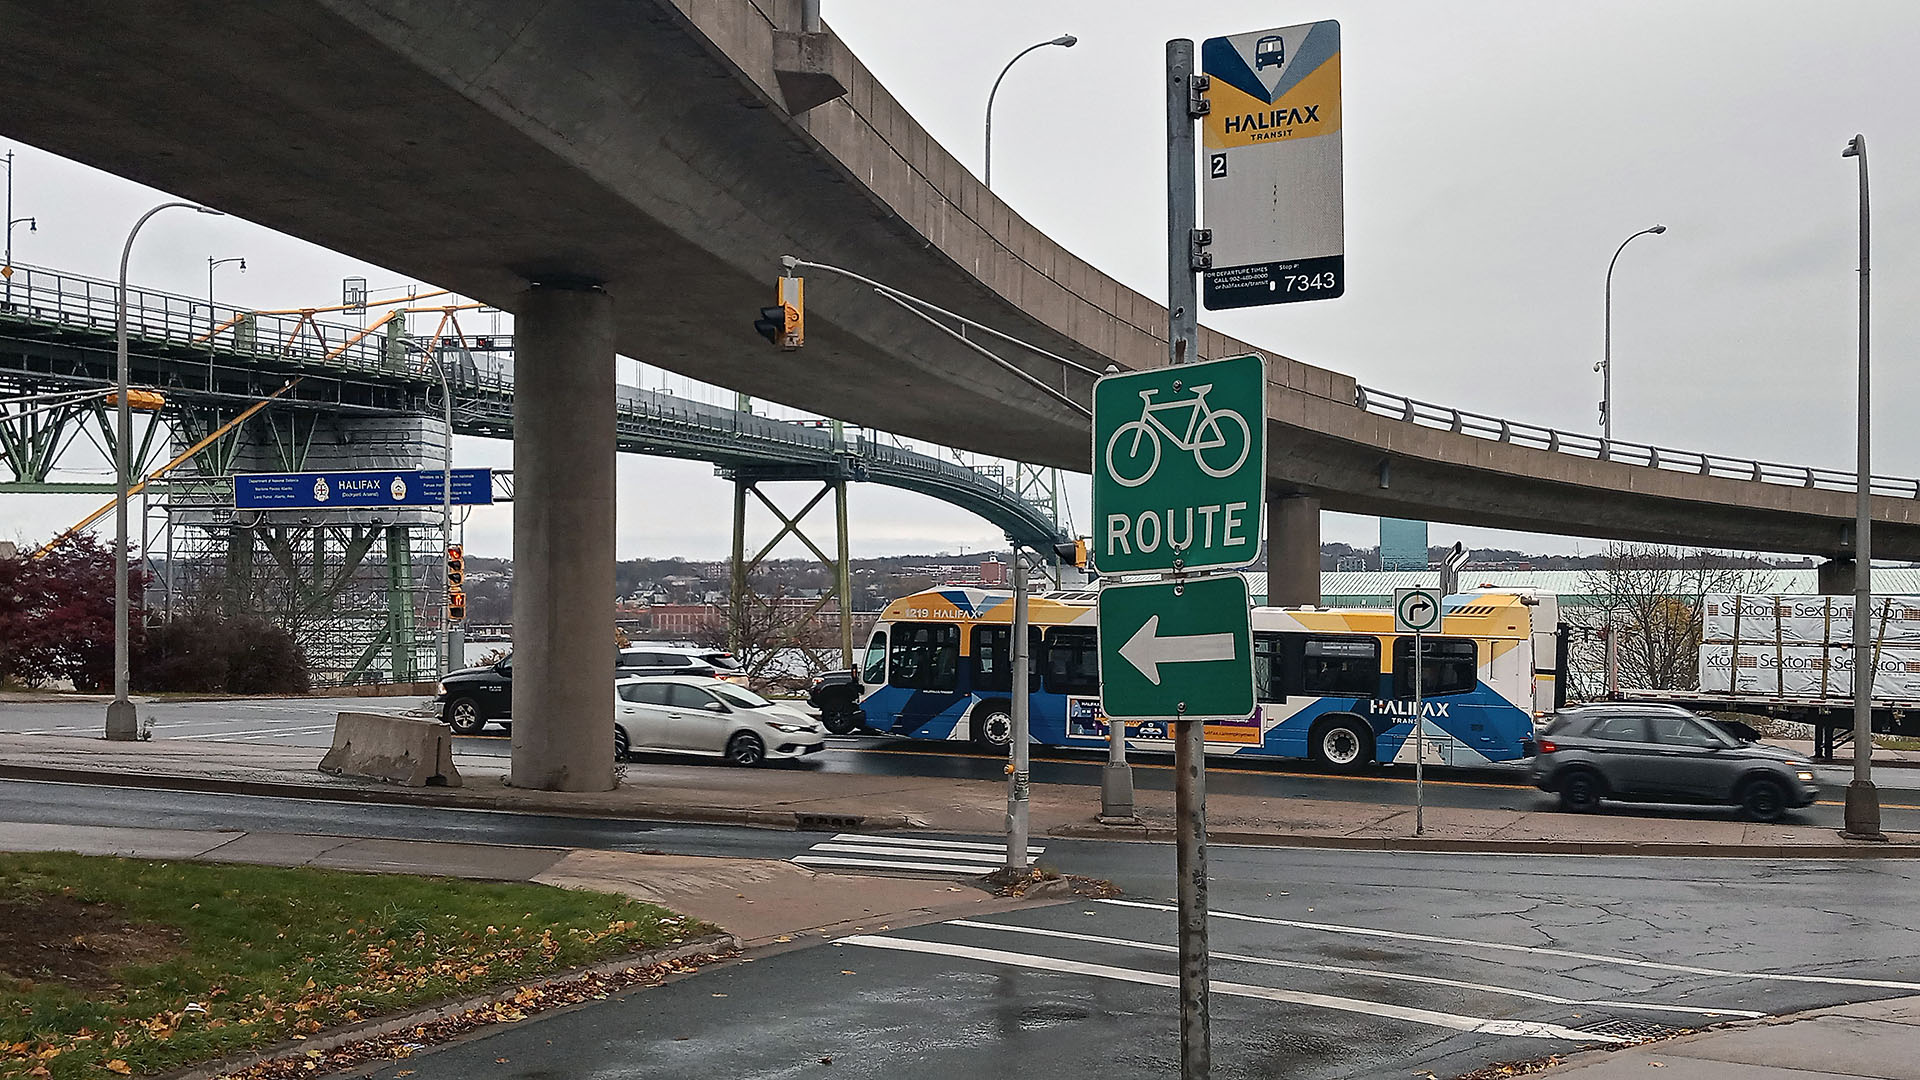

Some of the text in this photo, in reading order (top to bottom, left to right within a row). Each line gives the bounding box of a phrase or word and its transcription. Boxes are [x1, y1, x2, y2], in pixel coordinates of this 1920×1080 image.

[1225, 104, 1319, 133] HALIFAX
[1250, 130, 1293, 141] TRANSIT
[1213, 156, 1225, 176] 2
[1216, 268, 1250, 277] DEPARTURE
[1284, 272, 1335, 293] 7343
[338, 480, 381, 490] HALIFAX
[1107, 501, 1247, 556] ROUTE
[905, 608, 978, 619] 1219 HALIFAX
